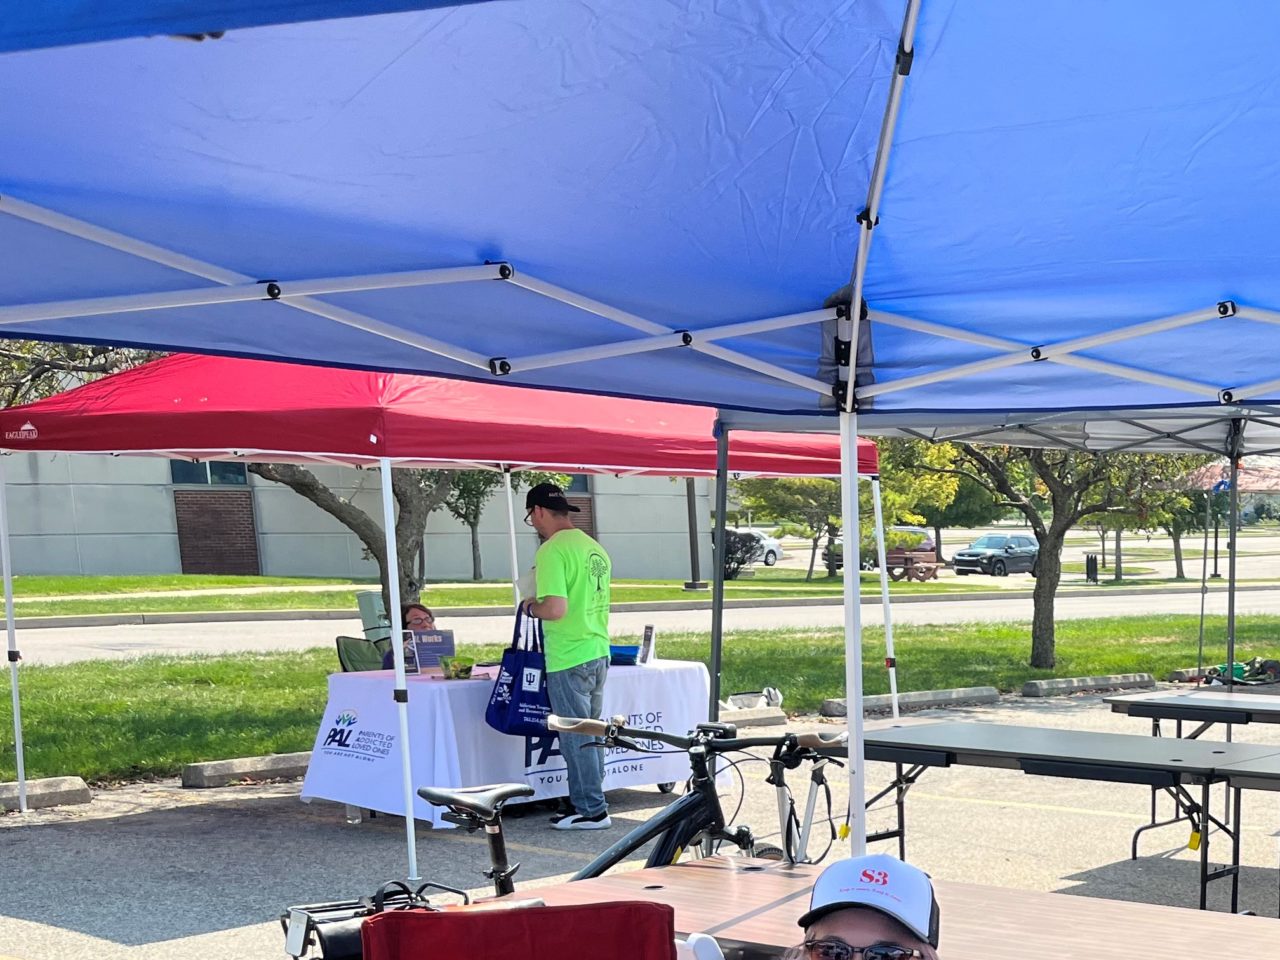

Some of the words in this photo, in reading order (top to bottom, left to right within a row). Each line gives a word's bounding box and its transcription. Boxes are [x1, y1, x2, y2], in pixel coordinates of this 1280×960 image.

[646, 712, 662, 723] OF
[323, 727, 353, 748] PAL
[359, 730, 385, 740] PARENTS
[355, 736, 393, 748] ADDICTED
[351, 742, 371, 752] LOVED
[372, 746, 390, 755] ONES
[525, 736, 563, 768] PA
[604, 746, 629, 757] OVED
[611, 763, 644, 775] ALONE
[539, 775, 562, 784] YOU
[859, 869, 889, 887] S3
